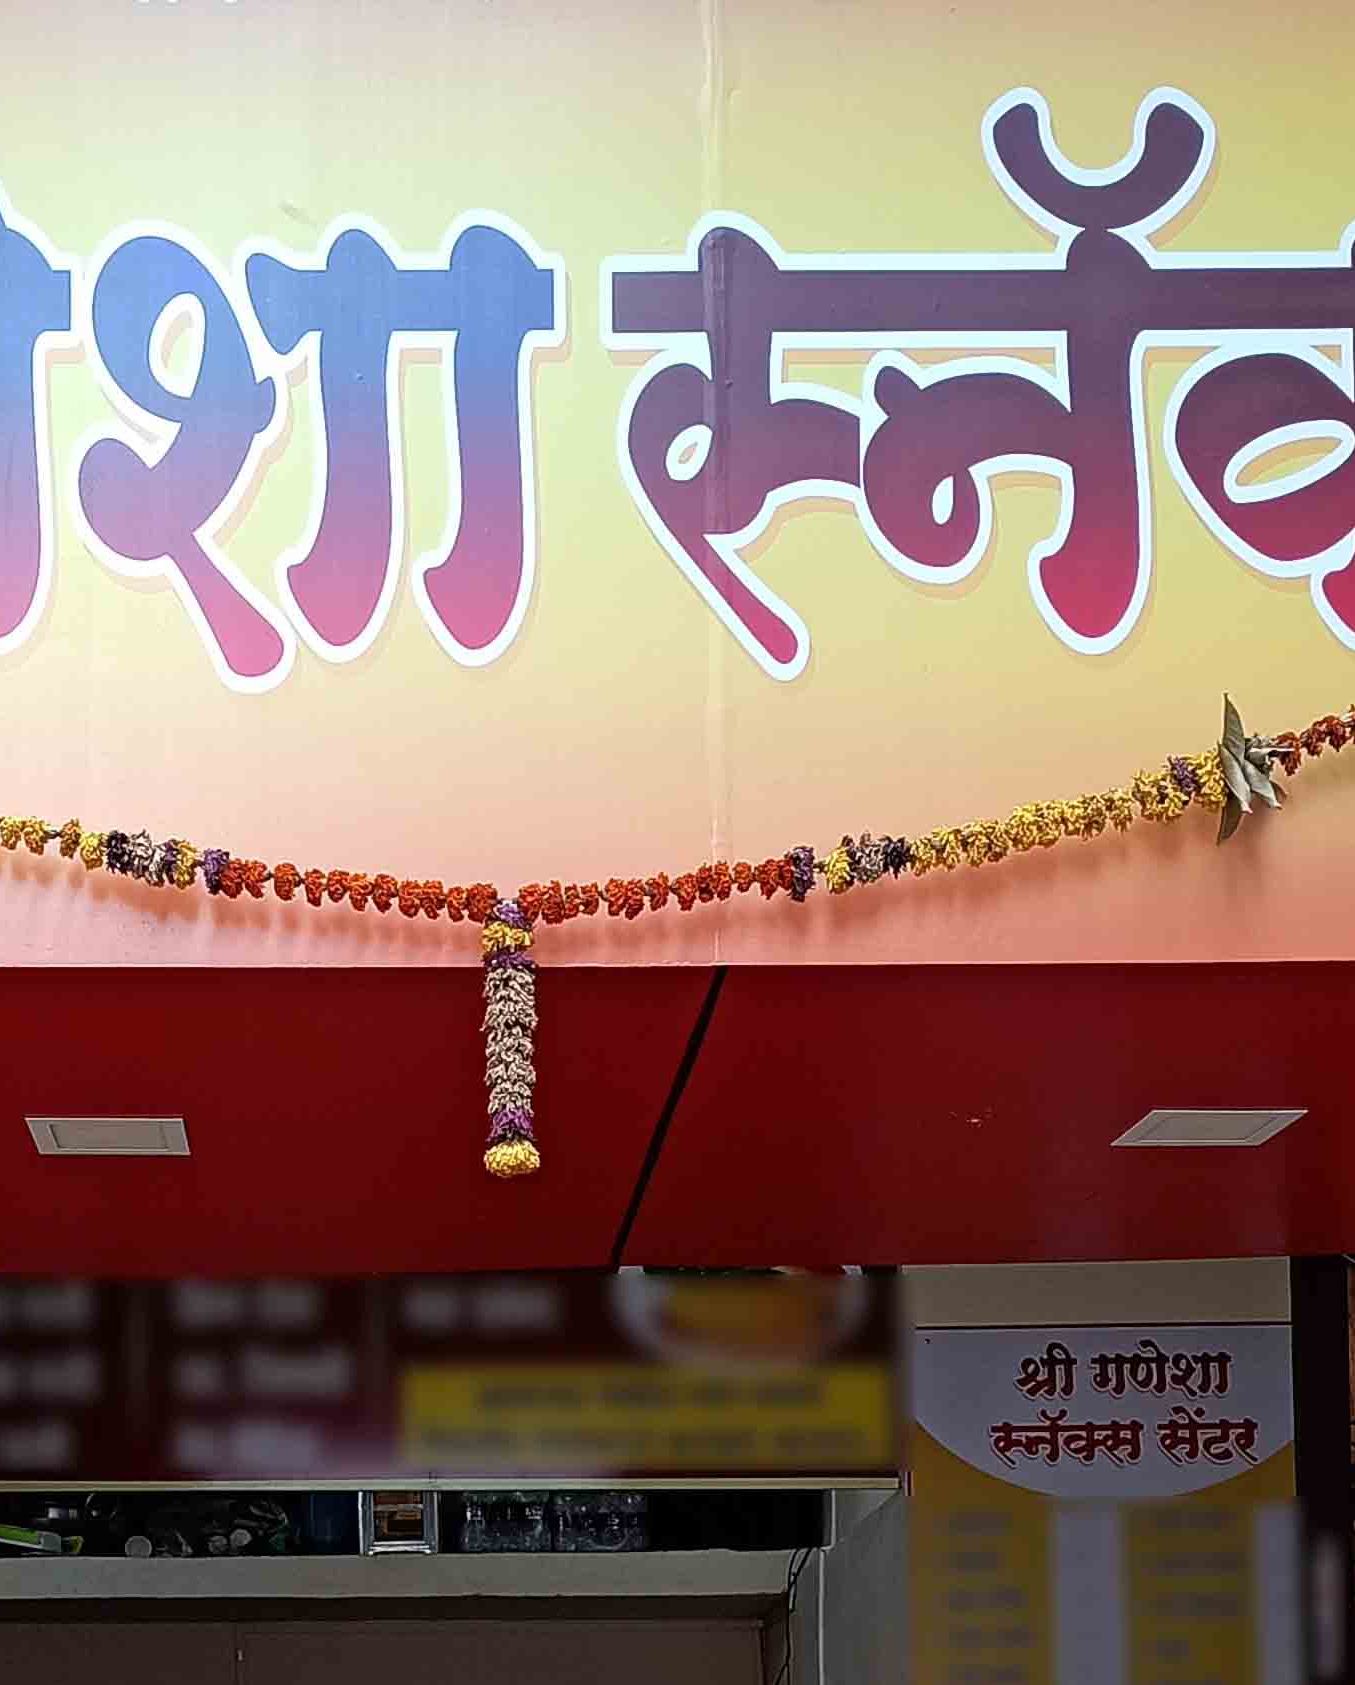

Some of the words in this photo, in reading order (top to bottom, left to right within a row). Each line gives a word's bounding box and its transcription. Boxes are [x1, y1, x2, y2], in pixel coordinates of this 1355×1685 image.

[1015, 1341, 1077, 1399] श्री
[1091, 1339, 1232, 1398] गणेशा
[990, 1408, 1144, 1467] स्नॅक्स
[1156, 1405, 1259, 1466] सेंटर
